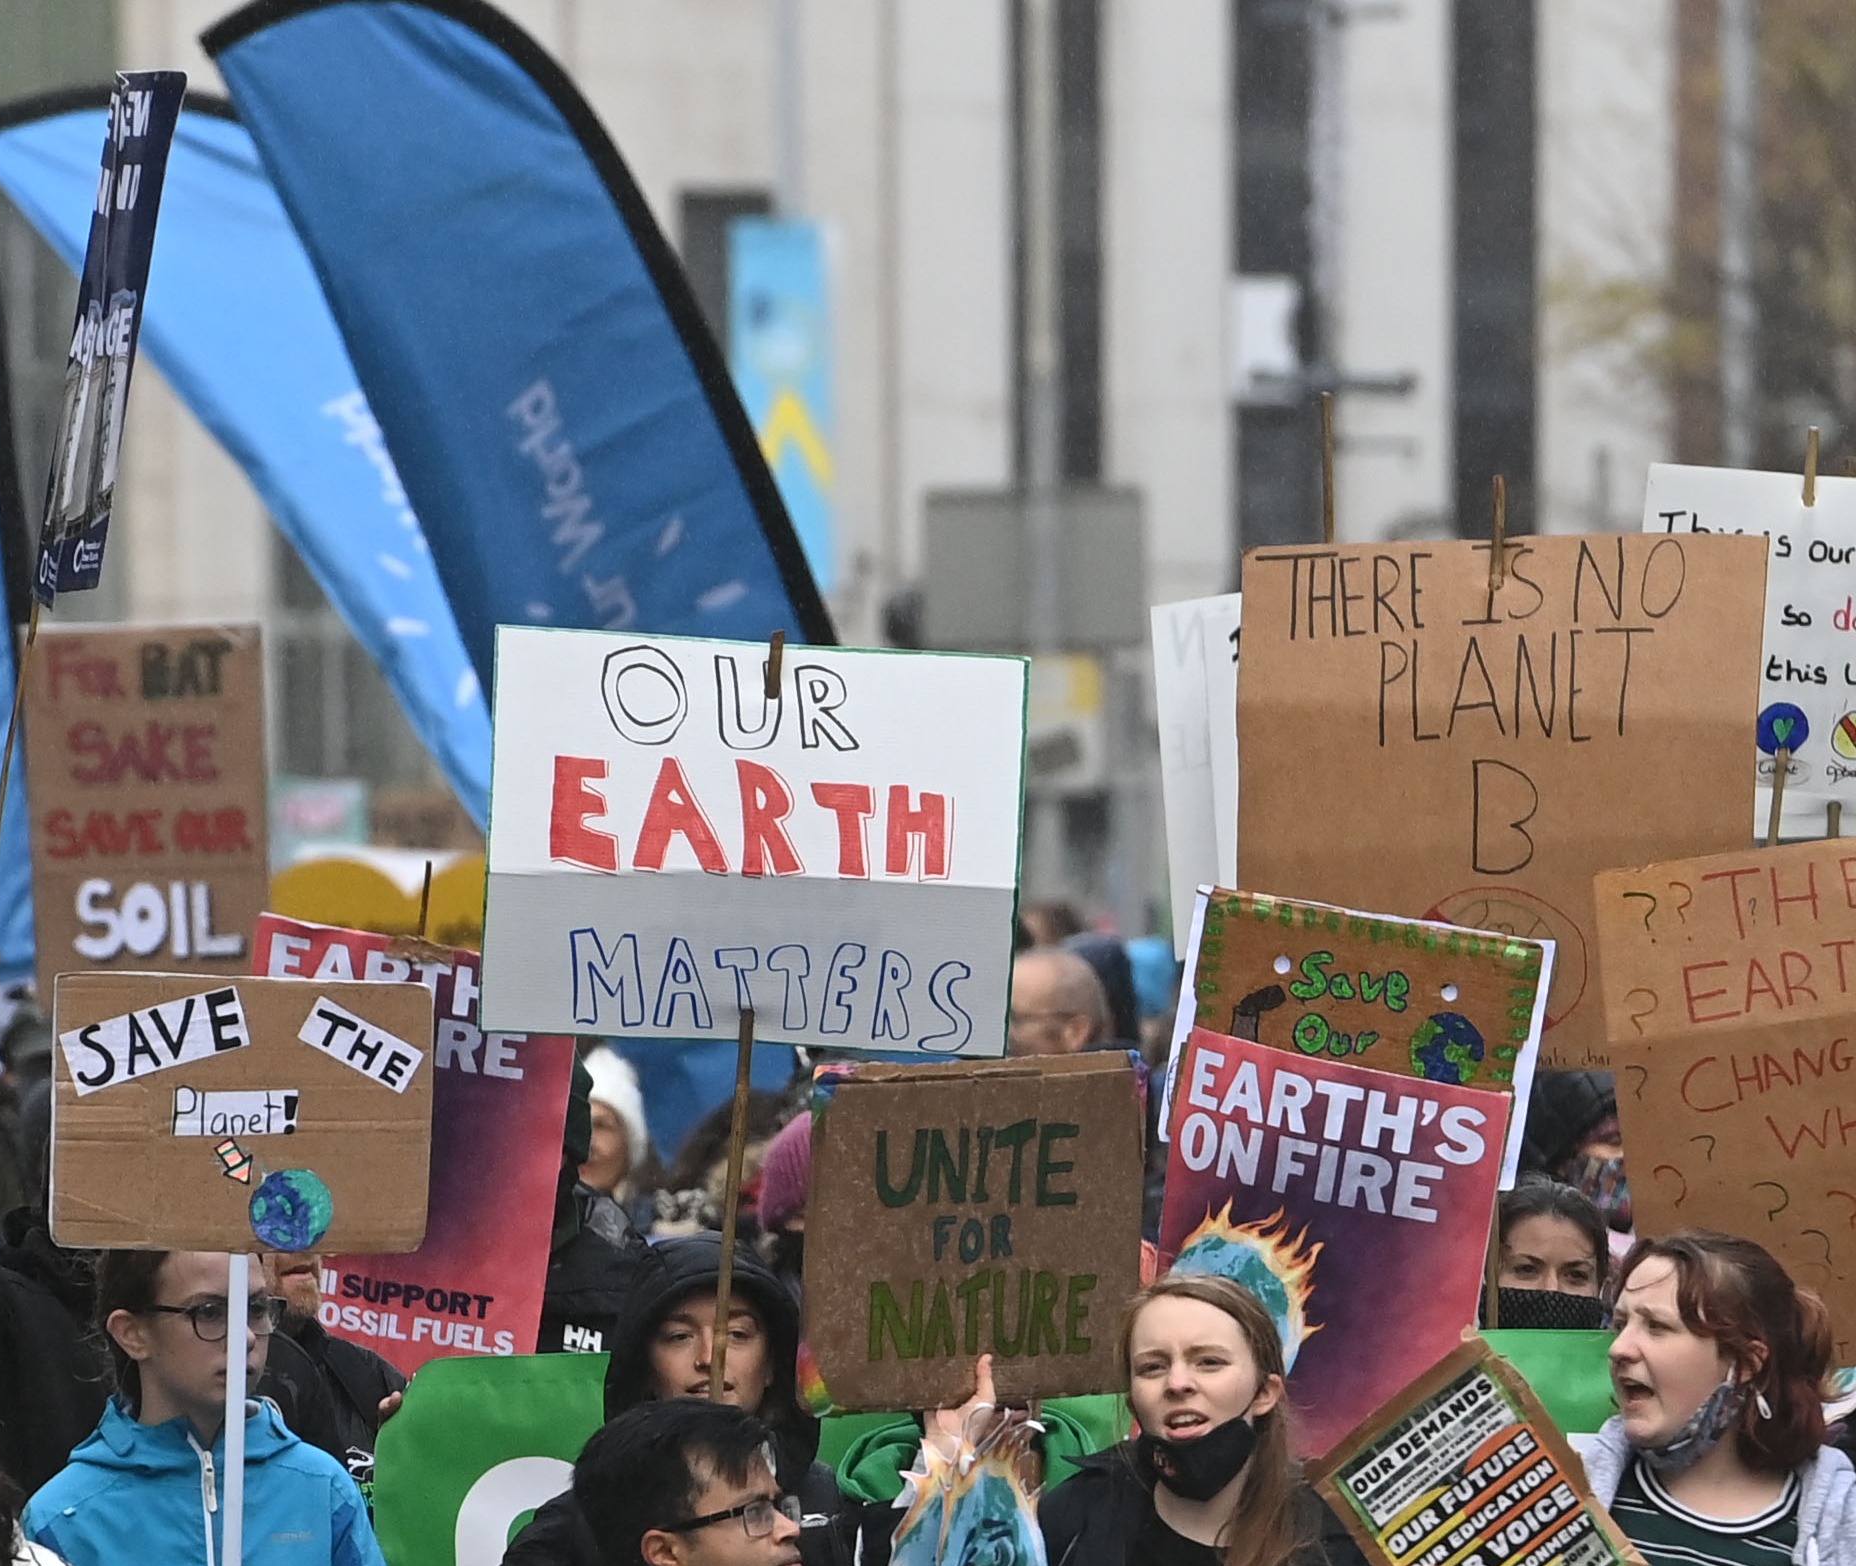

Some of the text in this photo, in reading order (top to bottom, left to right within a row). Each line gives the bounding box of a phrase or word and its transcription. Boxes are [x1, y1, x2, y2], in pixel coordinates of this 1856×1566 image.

[507, 379, 607, 573] World
[1255, 537, 1687, 640] THERE IS NO
[1808, 540, 1856, 565] Our
[1781, 603, 1813, 628] so
[601, 645, 860, 752] OUR
[1379, 627, 1655, 747] PLANET
[1765, 653, 1829, 686] this
[66, 720, 218, 785] SAKE
[45, 805, 254, 860] SAVE OUR
[549, 755, 955, 883] EARTH
[1471, 759, 1539, 875] B
[73, 878, 246, 961] SOIL
[569, 927, 973, 1053] MATTERS
[1289, 950, 1410, 1013] Save
[76, 987, 413, 1087] SAVE THE
[1293, 1013, 1380, 1056] Our
[173, 1085, 298, 1136] Planet!
[1188, 1046, 1488, 1166] EARTH'S
[875, 1118, 1080, 1208] UNITE
[1179, 1112, 1446, 1224] ON FIRE
[932, 1213, 1014, 1265] FOR
[317, 1300, 516, 1356] OSSIL FUELS
[340, 1274, 495, 1320] SUPPORT
[867, 1268, 1097, 1362] NATURE
[1351, 1377, 1494, 1496] OUR DEMANDS
[1387, 1430, 1537, 1556] OUR FUTURE
[1450, 1459, 1556, 1546] EDUCATION
[1485, 1484, 1578, 1559] VOICE
